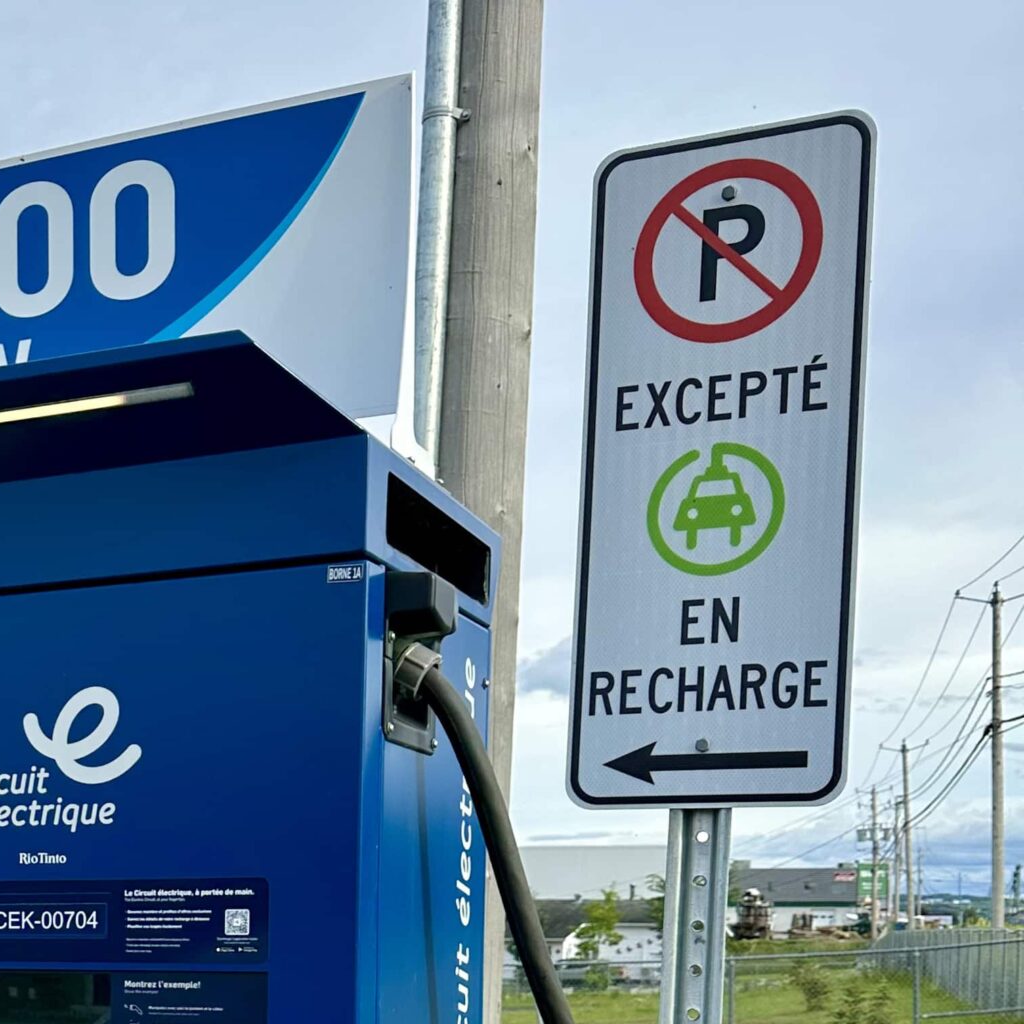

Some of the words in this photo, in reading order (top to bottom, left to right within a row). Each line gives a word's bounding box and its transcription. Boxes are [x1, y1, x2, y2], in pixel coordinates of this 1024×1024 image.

[614, 355, 829, 431] EXCEPTÉ
[329, 567, 351, 580] BORNE
[352, 566, 361, 579] 1A
[679, 596, 741, 646] EN
[587, 660, 829, 716] RECHARGE
[456, 656, 476, 927] électue
[134, 889, 156, 897] Circuit
[157, 889, 194, 897] électrique,
[201, 888, 223, 897] portée
[124, 980, 157, 989] Montrez
[158, 980, 201, 990] l'exemple!
